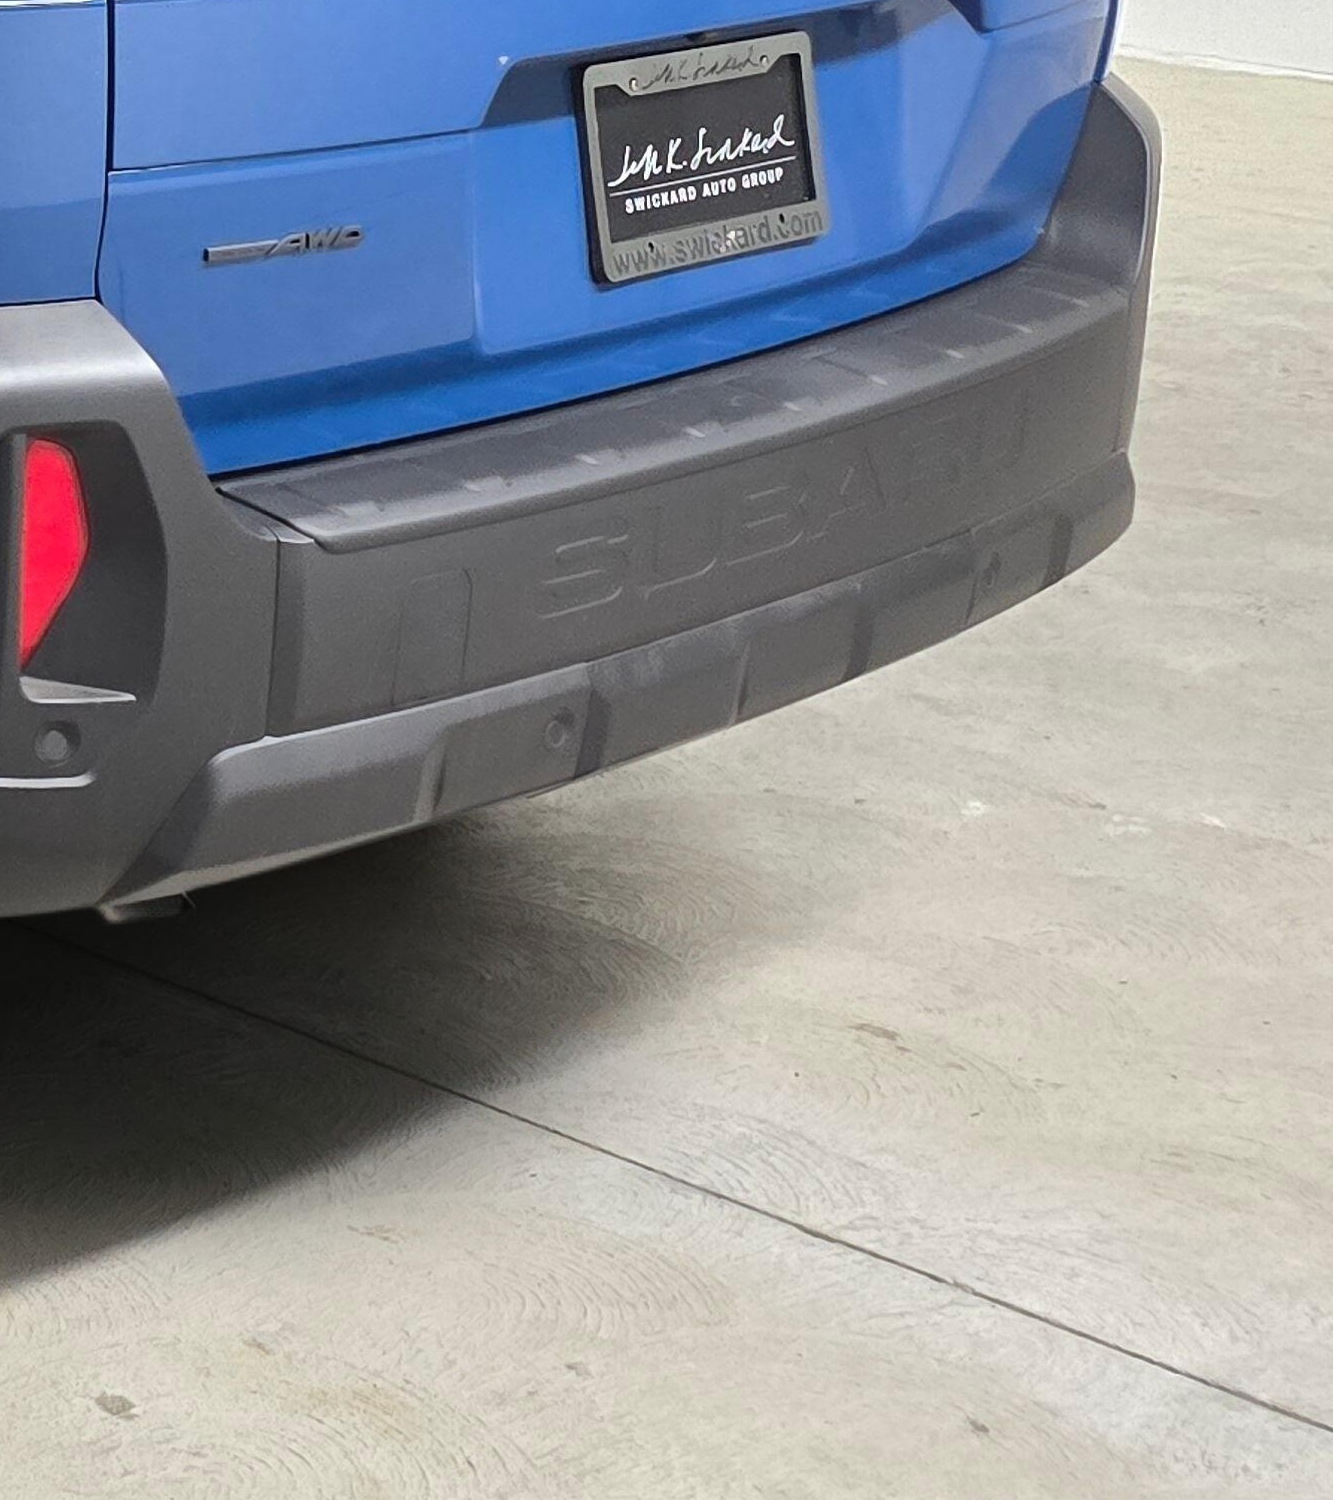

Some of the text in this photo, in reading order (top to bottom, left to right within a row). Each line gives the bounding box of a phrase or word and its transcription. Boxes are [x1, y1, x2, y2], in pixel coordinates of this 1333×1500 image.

[624, 166, 785, 214] SWICKARD AUTO GROUP
[611, 209, 824, 277] www.swickard.com
